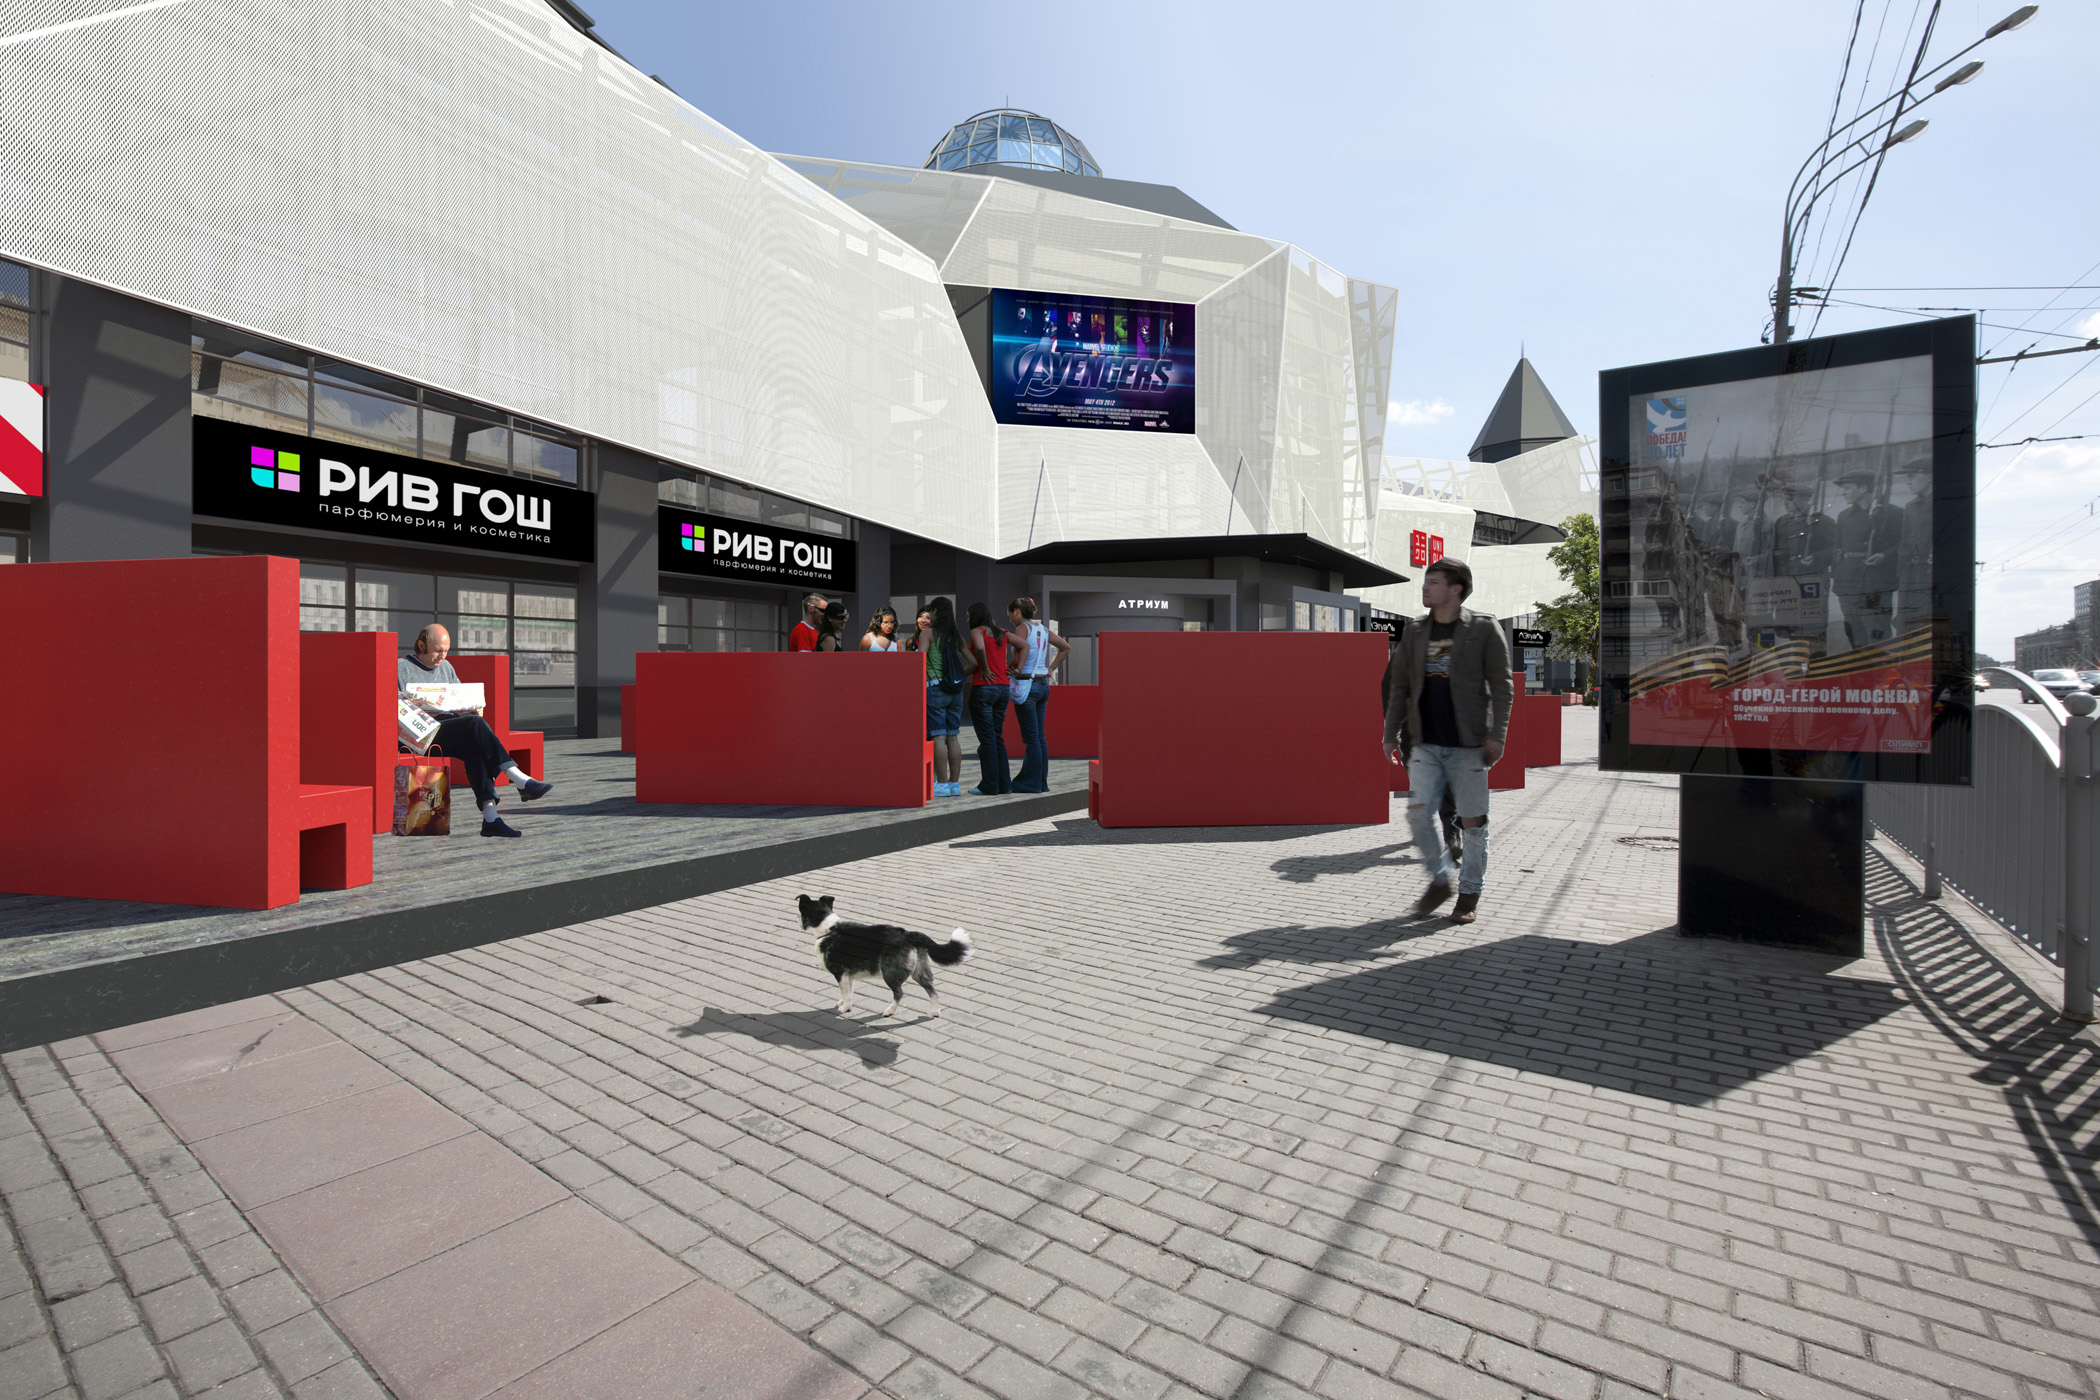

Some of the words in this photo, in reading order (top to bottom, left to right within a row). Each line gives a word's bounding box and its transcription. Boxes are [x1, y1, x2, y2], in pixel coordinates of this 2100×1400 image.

[1013, 337, 1174, 397] AVENGERS
[1647, 431, 1687, 446] ПОБЕДА!
[1648, 446, 1662, 461] 70
[1664, 444, 1686, 459] ЛЕТ
[319, 458, 439, 512] РИВ
[453, 482, 551, 531] ГОШ
[319, 503, 446, 530] парфюмерия
[453, 523, 463, 531] и
[470, 525, 551, 544] косметика
[713, 528, 773, 562] РИВ
[779, 539, 832, 570] ГОШ
[1433, 539, 1443, 552] UNI
[713, 558, 777, 573] парфюмерия
[788, 568, 832, 580] косметика
[1118, 599, 1169, 609] АТРИУМ
[1733, 686, 1841, 704] ГОРОД-ГЕРОЙ
[1845, 689, 1920, 704] МОСКВА
[1733, 704, 1774, 713] Обучение
[1775, 705, 1825, 713] москвичей
[1826, 706, 1871, 715] военному
[1872, 707, 1899, 715] делу.
[1753, 715, 1769, 723] год
